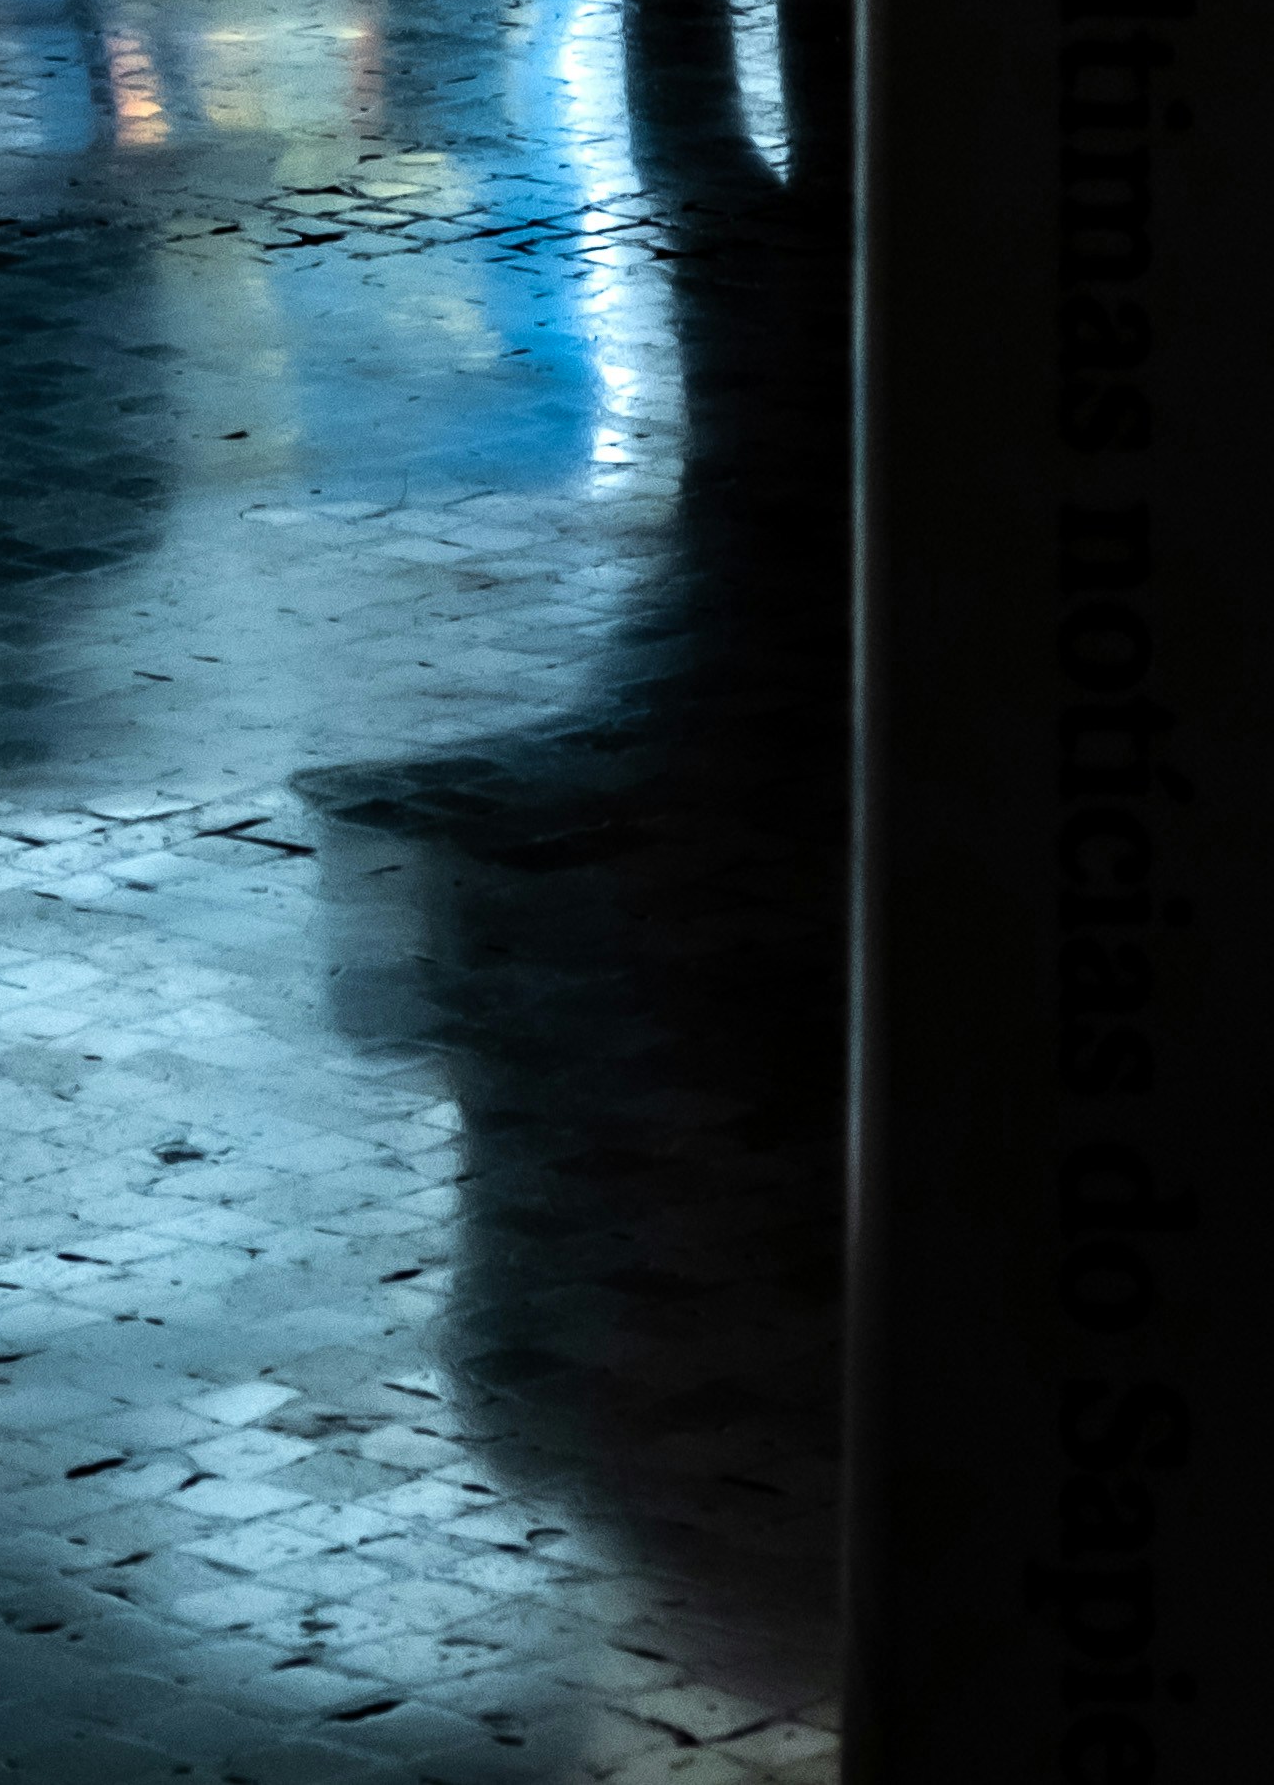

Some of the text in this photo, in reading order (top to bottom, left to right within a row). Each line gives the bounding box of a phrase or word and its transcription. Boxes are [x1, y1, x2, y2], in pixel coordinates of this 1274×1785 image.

[1055, 501, 1195, 1098] notícias
[1056, 1141, 1200, 1335] do
[1022, 1377, 1199, 1785] Sapie
